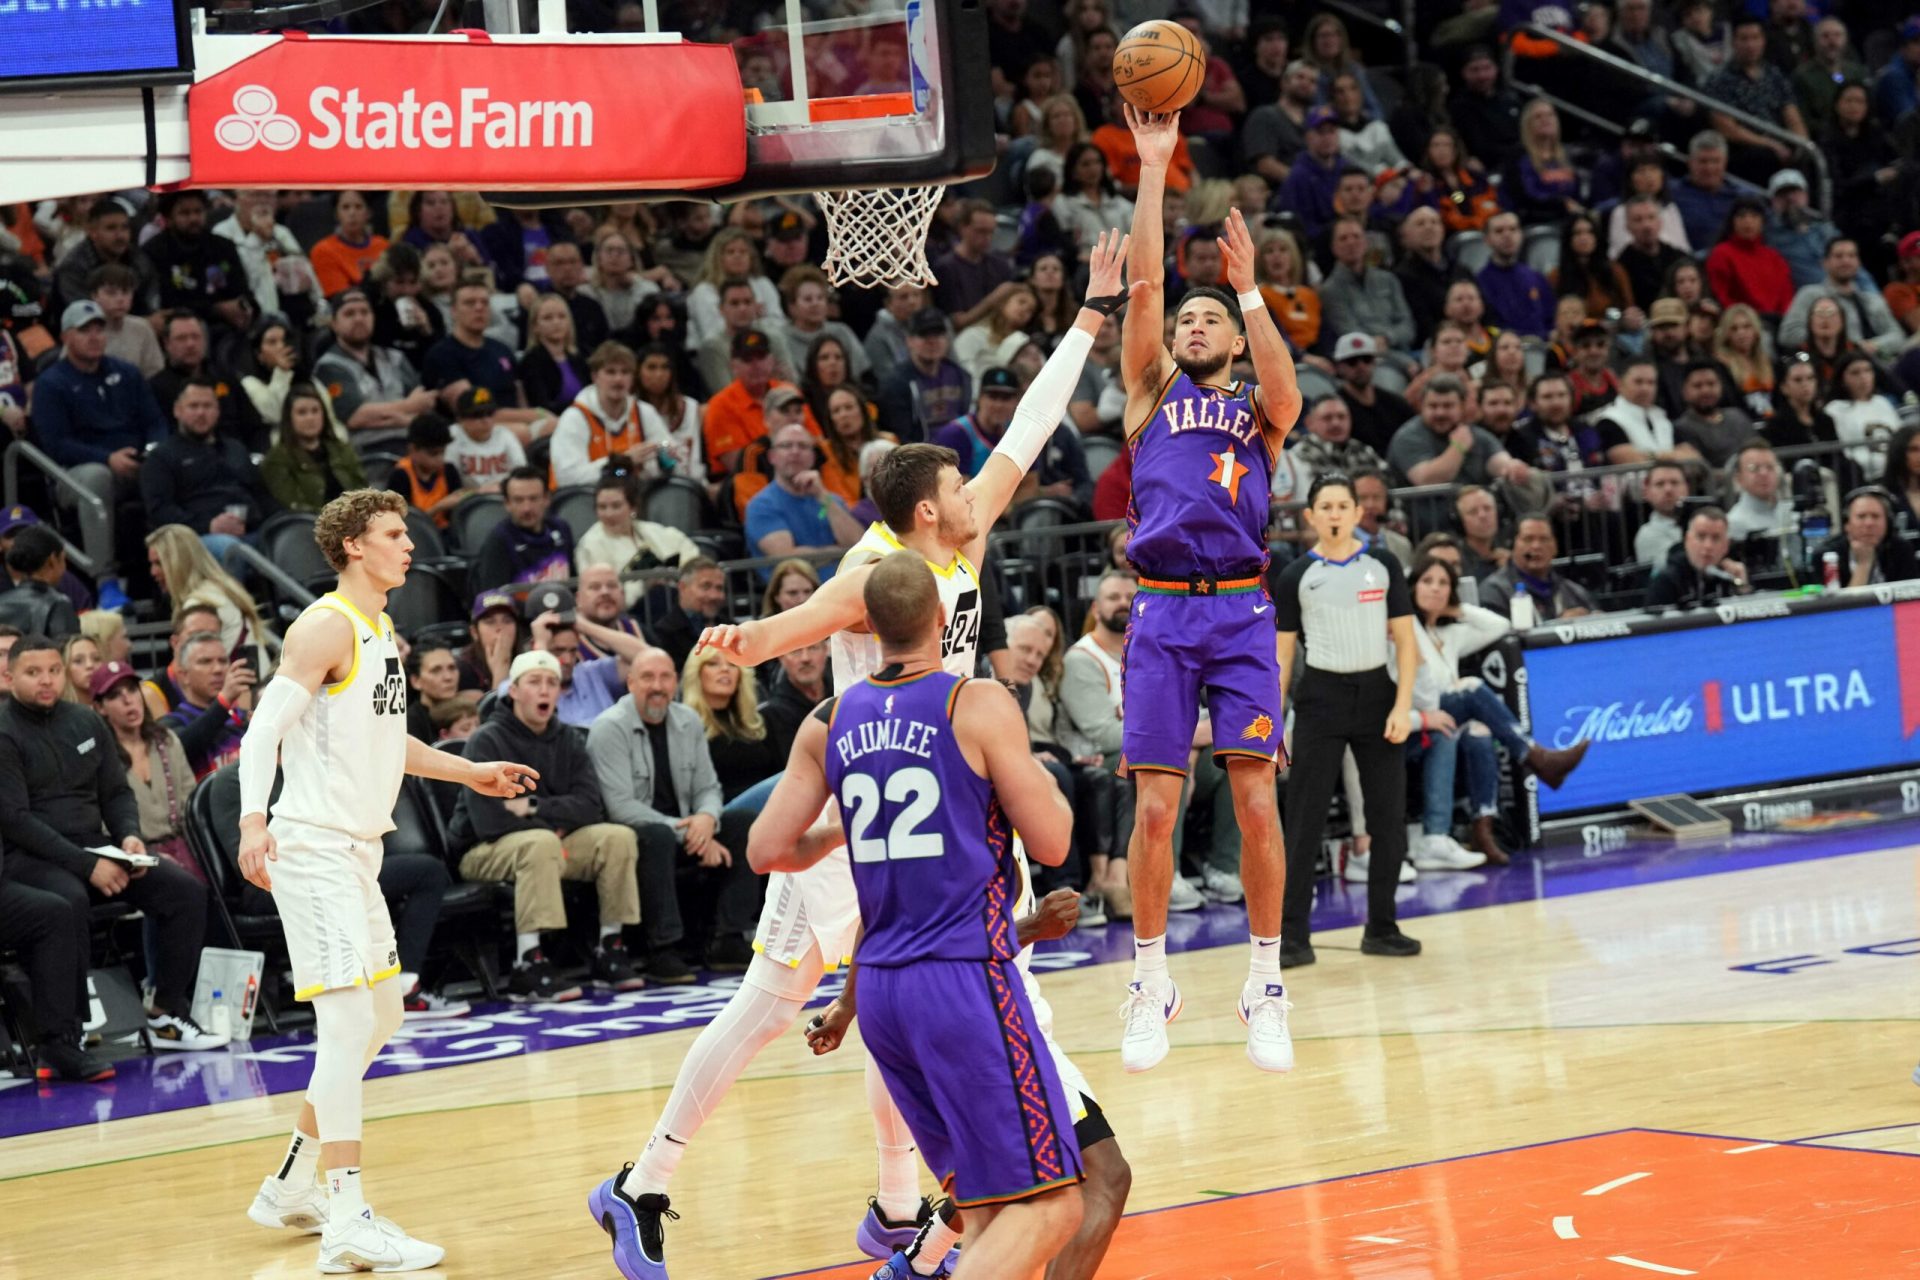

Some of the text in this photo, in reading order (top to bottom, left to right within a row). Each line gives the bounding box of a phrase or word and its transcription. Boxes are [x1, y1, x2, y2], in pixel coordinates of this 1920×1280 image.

[1162, 397, 1260, 447] VALLEY
[1220, 451, 1236, 489] 1
[952, 609, 979, 655] 24
[388, 677, 406, 715] 23
[1553, 668, 1873, 751] Michelob ULTRA
[836, 718, 938, 767] PLUMLEE
[841, 766, 945, 863] 22
